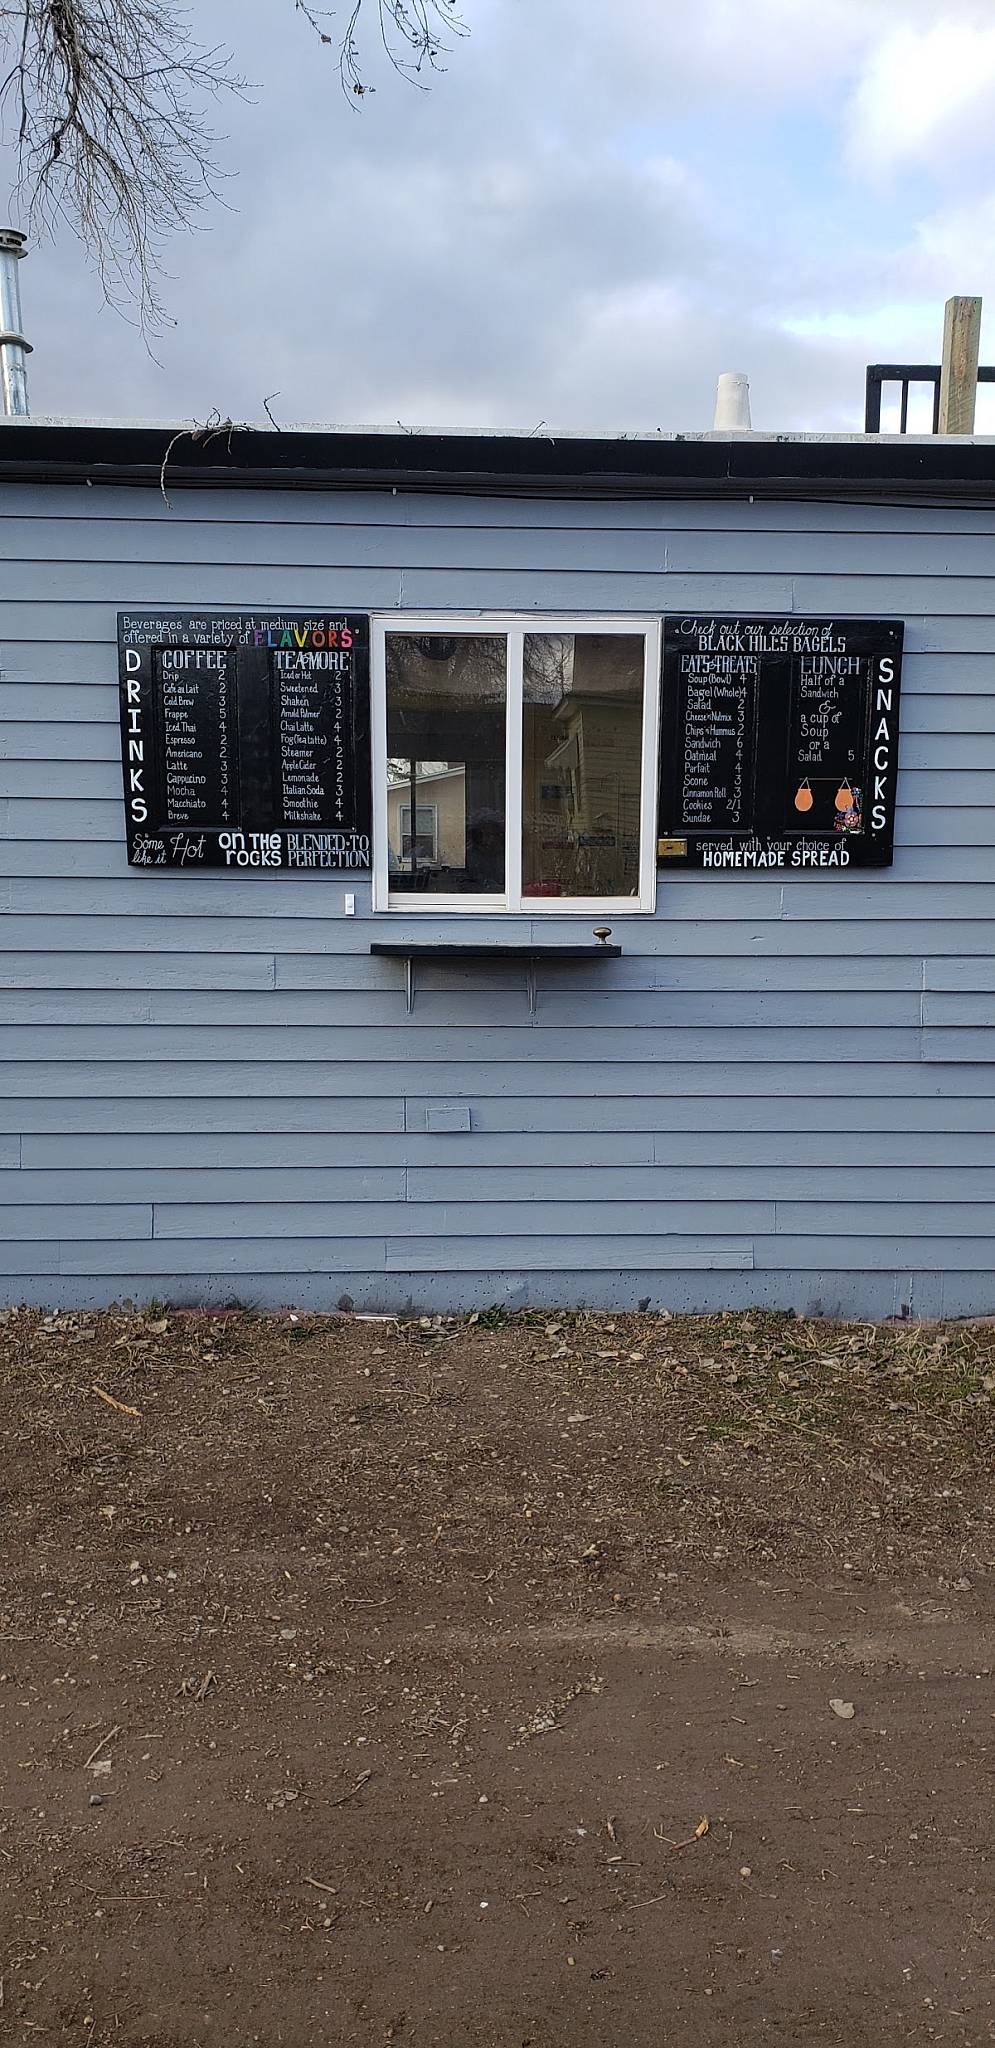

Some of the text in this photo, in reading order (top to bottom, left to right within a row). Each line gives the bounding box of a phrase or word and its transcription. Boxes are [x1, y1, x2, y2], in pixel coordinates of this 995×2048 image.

[123, 616, 347, 633] Beverages are priced at medium size and
[680, 619, 833, 640] Check out our selection of
[123, 628, 353, 648] offered in a variety of FLAVORS
[699, 635, 847, 653] BLACK HILLS BAGELS
[162, 649, 227, 669] COFFEE
[800, 656, 860, 675] LUNCH
[162, 669, 226, 682] Drip 2
[301, 670, 312, 680] Hot
[335, 670, 342, 681] 2
[687, 672, 708, 686] Soup
[739, 673, 747, 684] 4
[800, 674, 845, 686] Half of a
[185, 683, 199, 694] Lait
[218, 682, 227, 694] 2
[280, 681, 341, 694] Sweetened 3
[687, 685, 713, 702] Bagel
[741, 686, 748, 698] 4
[800, 685, 839, 698] Sandwich
[178, 695, 194, 706] Brew
[218, 695, 226, 707] 3
[280, 694, 342, 707] Shaken 3
[687, 698, 745, 710] Salad 2
[335, 708, 342, 719] 2
[818, 700, 836, 715] &
[164, 708, 227, 721] Frappe 5
[737, 710, 745, 722] 3
[800, 711, 842, 728] a cup of
[164, 721, 227, 733] Iced Thai 4
[280, 719, 296, 731] Chai
[333, 721, 342, 733] 4
[685, 723, 704, 737] Chips
[737, 723, 745, 736] 2
[800, 723, 829, 741] Soup
[125, 649, 148, 823] DRINKS
[165, 733, 228, 746] Espresso 2
[333, 734, 342, 746] 4
[684, 736, 744, 749] Sandwich 6
[809, 740, 830, 750] or a
[871, 657, 894, 830] SNACKS
[165, 746, 228, 758] Americano 2
[281, 745, 343, 758] Steamer 2
[684, 749, 743, 761] Oatmeal 4
[797, 749, 855, 762] Salad 5
[166, 760, 228, 771] Latte 3
[281, 758, 343, 771] Apple Cider 2
[684, 761, 743, 774] Parfait 4
[220, 773, 228, 785] 3
[282, 771, 344, 783] Lemonade 2
[683, 773, 742, 786] Scone 3
[167, 785, 229, 796] Mocha 4
[282, 783, 344, 796] Italian Soda 3
[682, 786, 742, 799] Cinnamon Roll 3
[167, 797, 229, 809] Macchiato 4
[282, 796, 344, 809] Smoothie 4
[682, 798, 741, 811] Cookies 2/1
[168, 809, 230, 821] Breve 4
[283, 810, 344, 821] Milkshake 4
[682, 811, 740, 823] Sundae 3
[132, 833, 164, 850] Some
[695, 837, 848, 857] served with your choice of
[131, 849, 167, 866] like it
[287, 850, 370, 867] PERFECTION
[703, 851, 850, 867] HOMEMADE SPREAD
